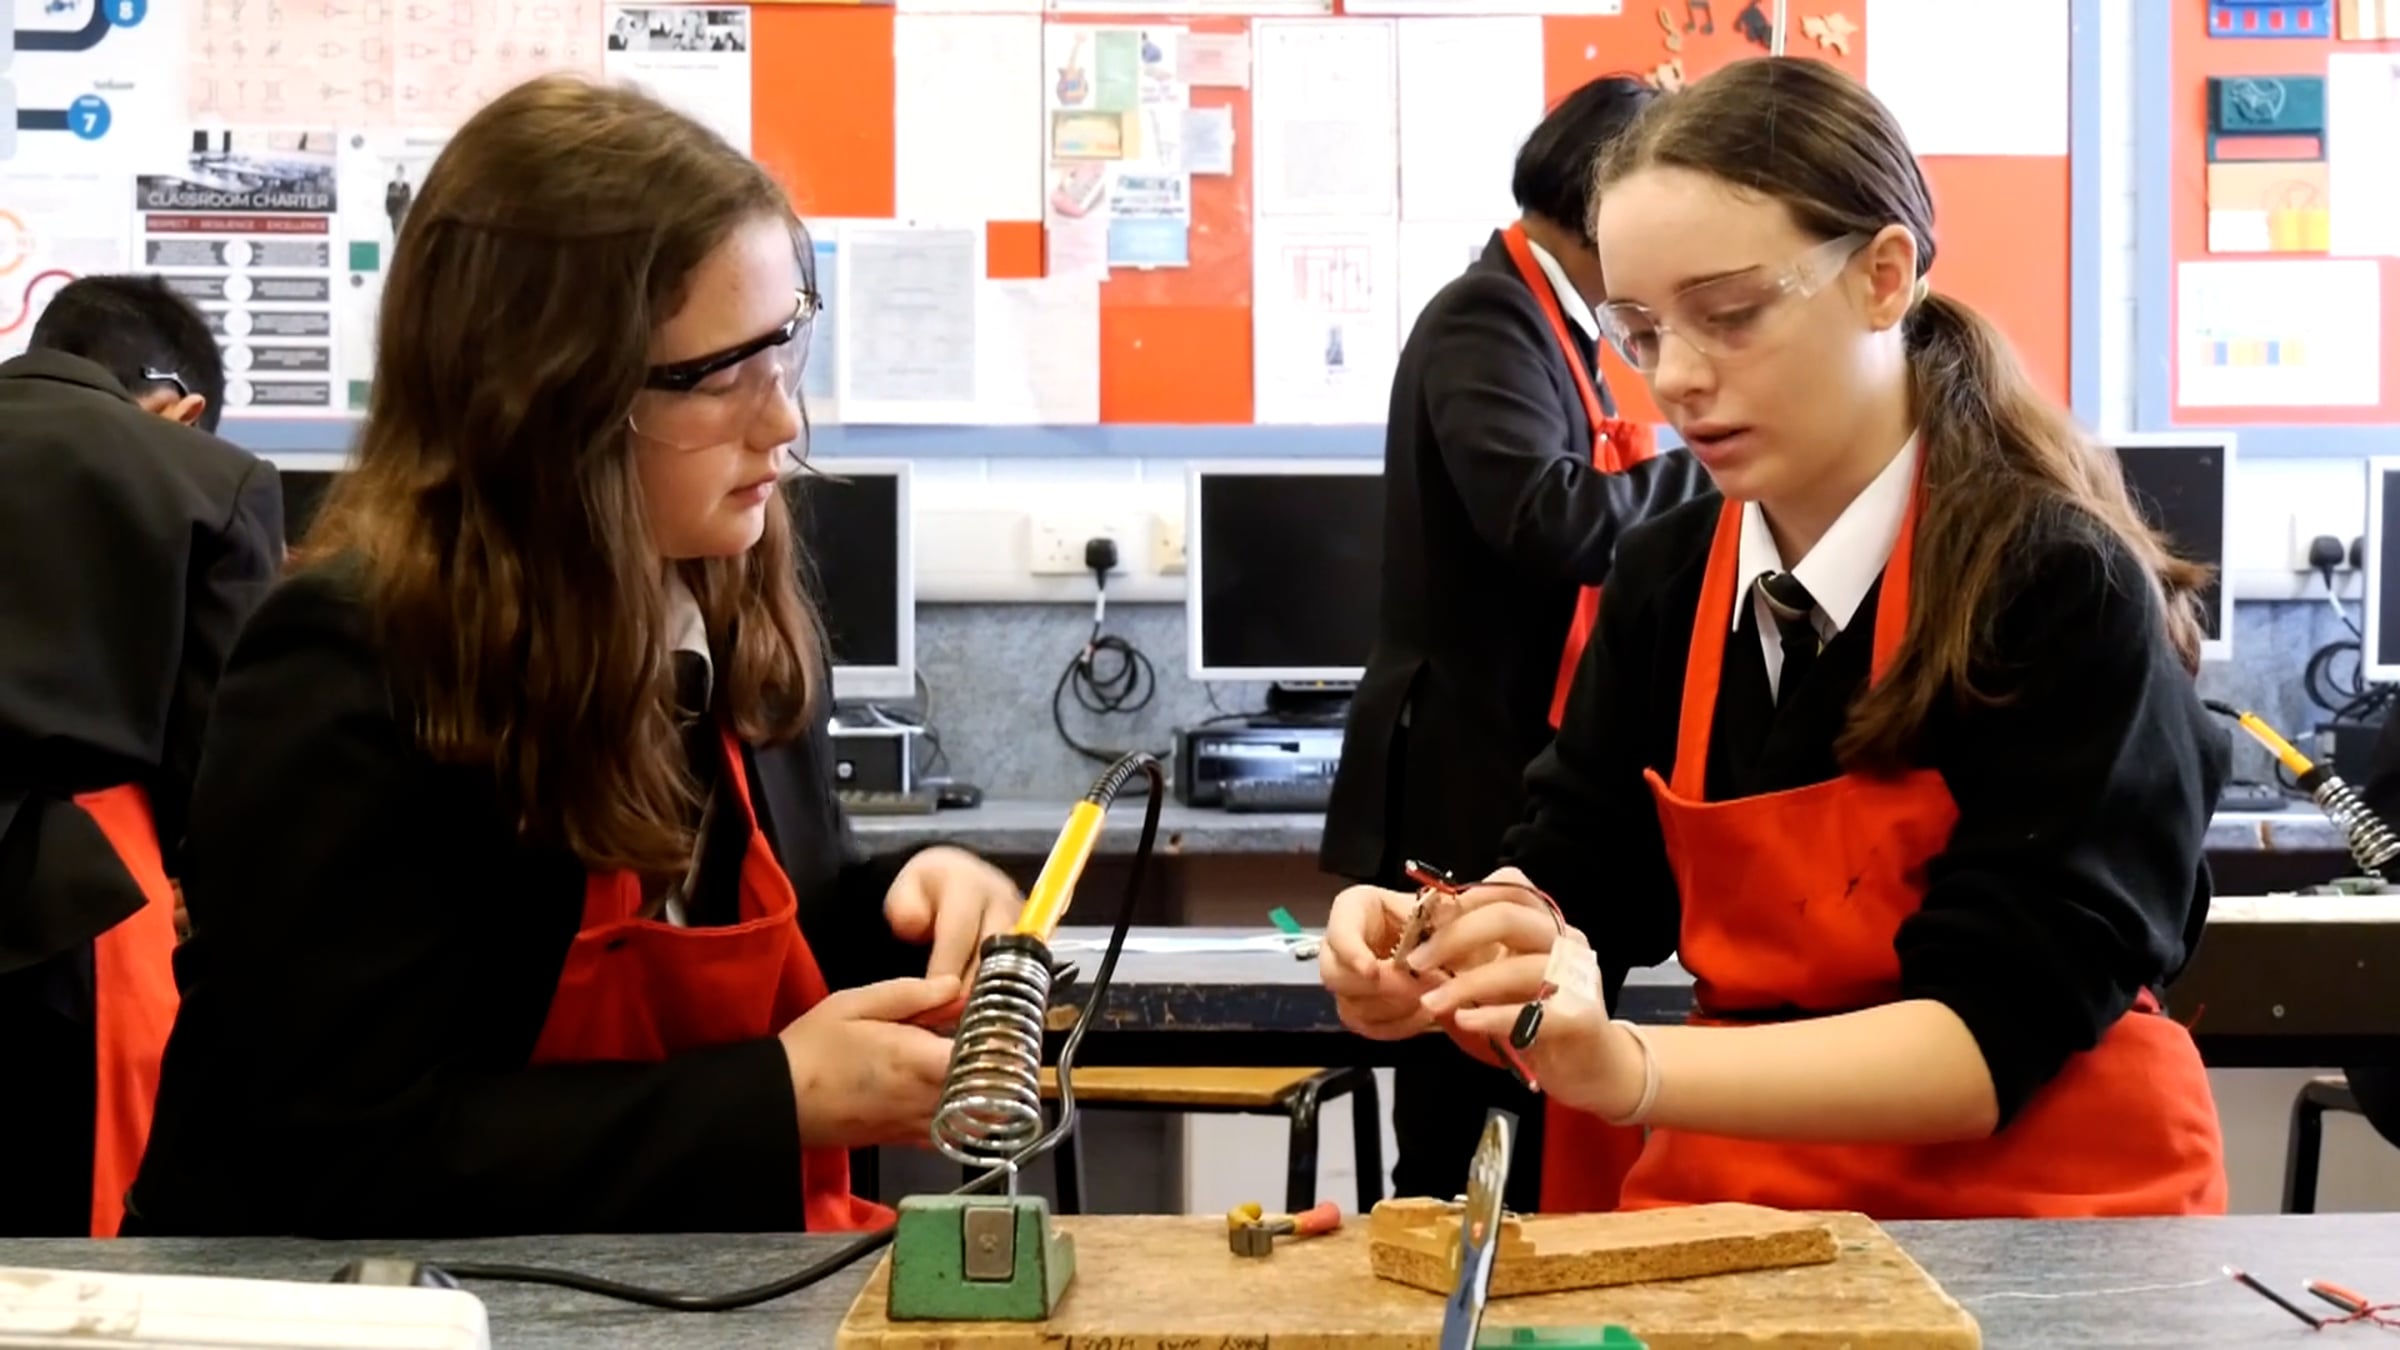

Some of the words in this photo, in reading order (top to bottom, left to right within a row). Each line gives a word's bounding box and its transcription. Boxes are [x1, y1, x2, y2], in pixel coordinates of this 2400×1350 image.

[119, 0, 134, 20] 8
[82, 112, 97, 133] 7
[148, 192, 249, 208] CLASSROOM
[252, 192, 329, 209] CHARTER
